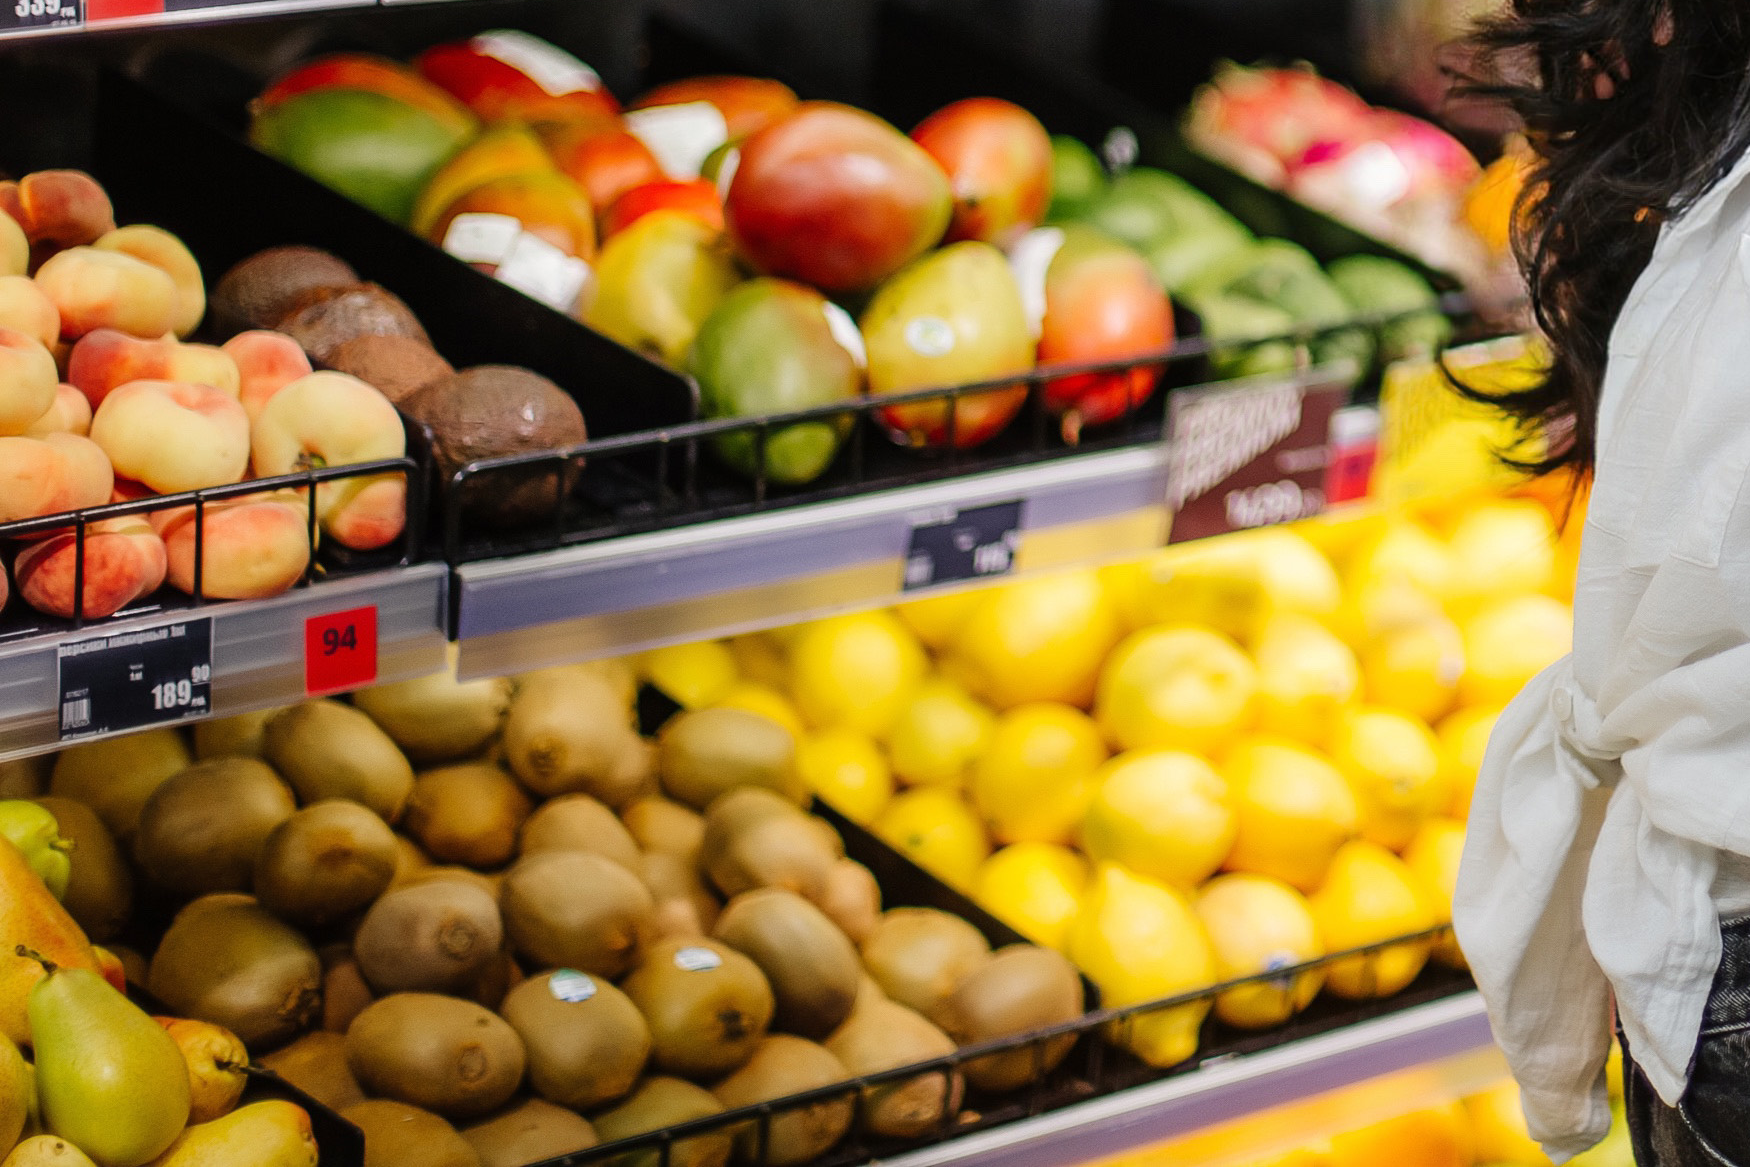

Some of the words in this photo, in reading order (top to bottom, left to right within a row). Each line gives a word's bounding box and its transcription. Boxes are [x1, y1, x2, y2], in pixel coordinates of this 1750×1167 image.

[323, 625, 357, 656] 94
[151, 679, 192, 710] 189
[191, 663, 210, 683] 90
